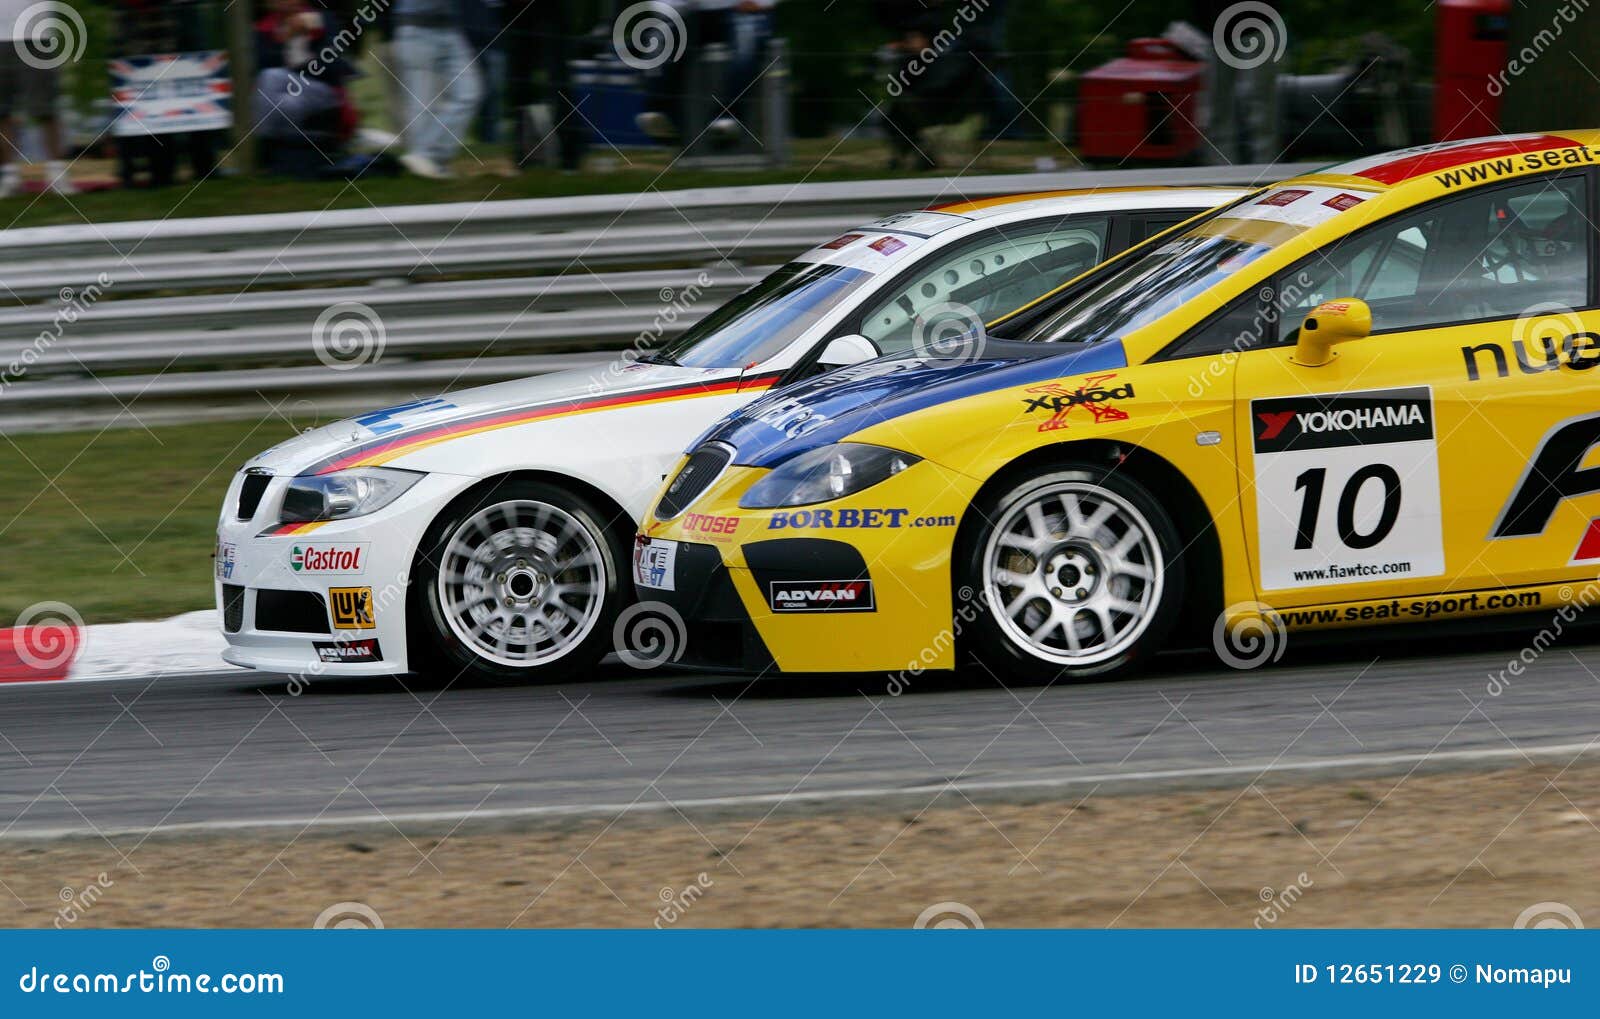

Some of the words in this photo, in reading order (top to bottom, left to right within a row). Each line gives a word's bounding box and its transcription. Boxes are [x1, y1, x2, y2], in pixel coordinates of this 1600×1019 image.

[1296, 404, 1425, 433] YOKOHAMA
[1294, 463, 1401, 550] 10
[304, 547, 360, 570] Castrol
[1294, 560, 1411, 581] www.fiawtcc.com
[776, 589, 856, 601] ADVAN
[1272, 590, 1541, 627] www.seat-sport.com
